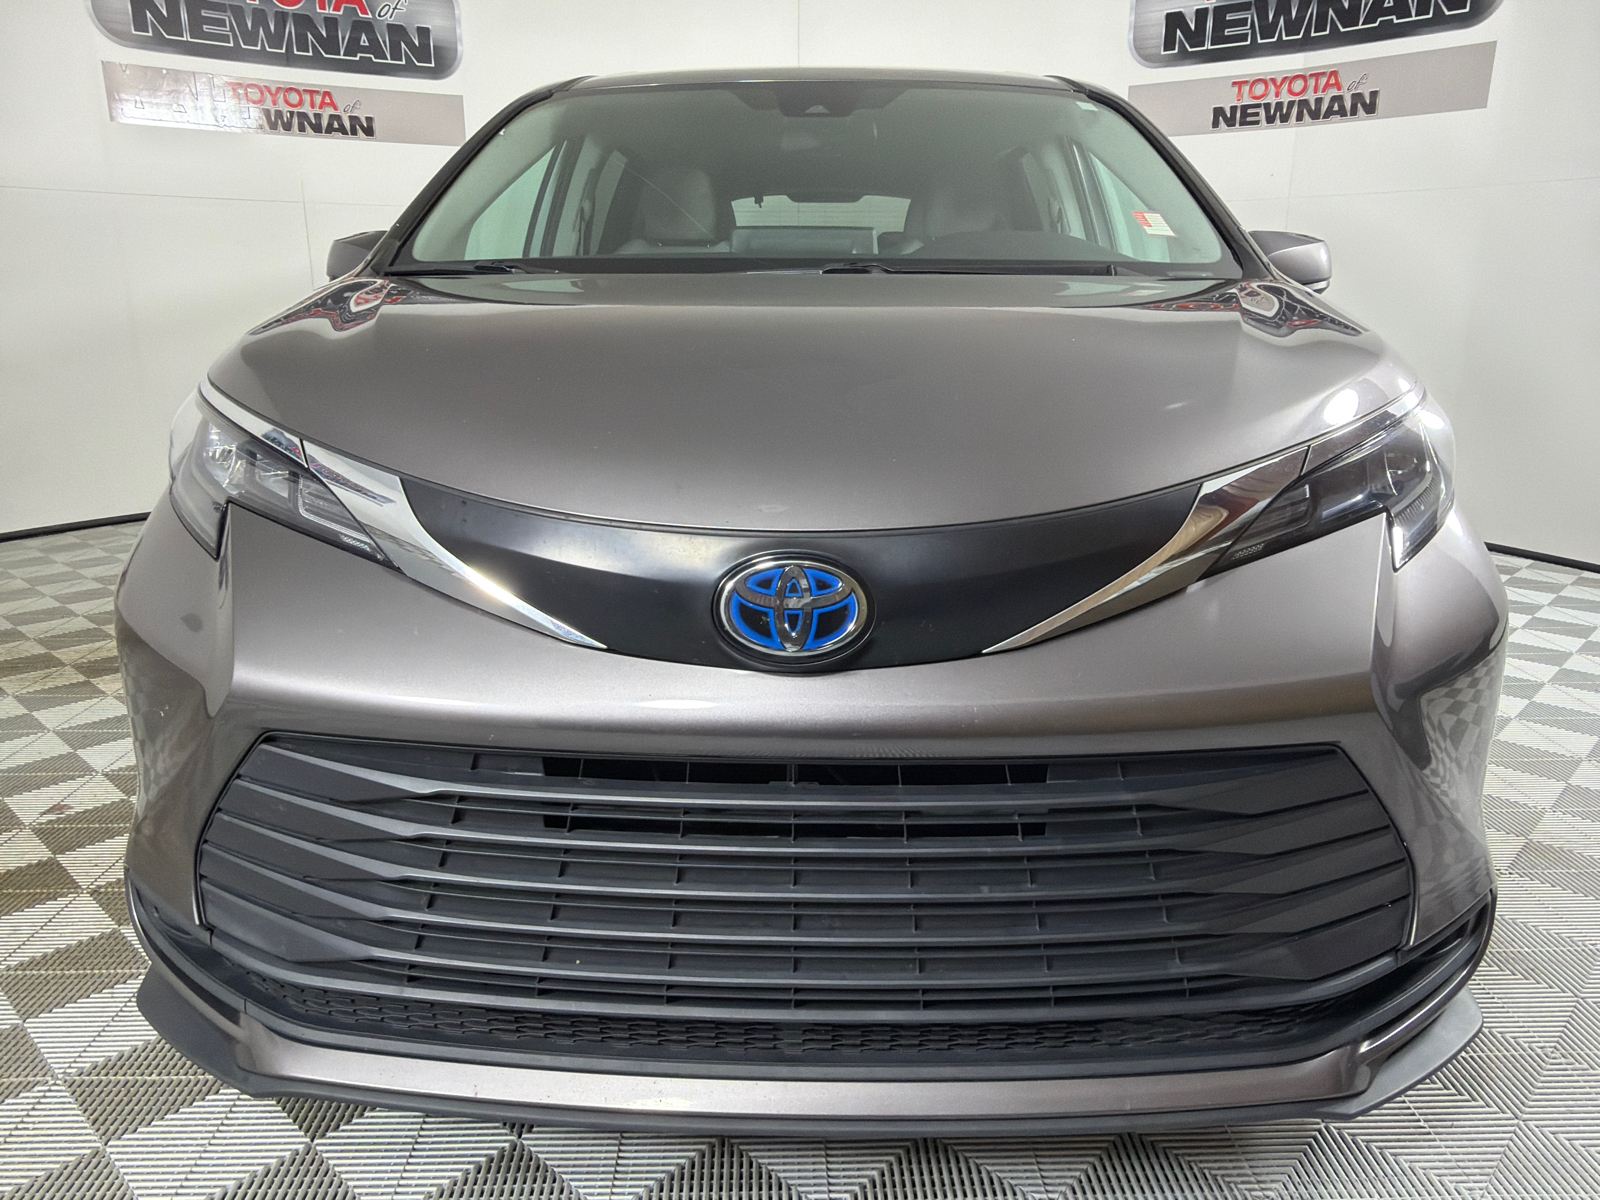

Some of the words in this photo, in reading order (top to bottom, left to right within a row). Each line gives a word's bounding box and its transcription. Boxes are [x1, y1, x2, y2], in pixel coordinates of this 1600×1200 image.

[130, 0, 435, 67] NEWNAN
[225, 81, 339, 112] TOYOTA
[343, 100, 361, 113] of
[1231, 70, 1343, 102] TOYOTA
[1346, 73, 1369, 92] of
[259, 107, 376, 138] WNAN
[1211, 90, 1379, 129] NEWNAN
